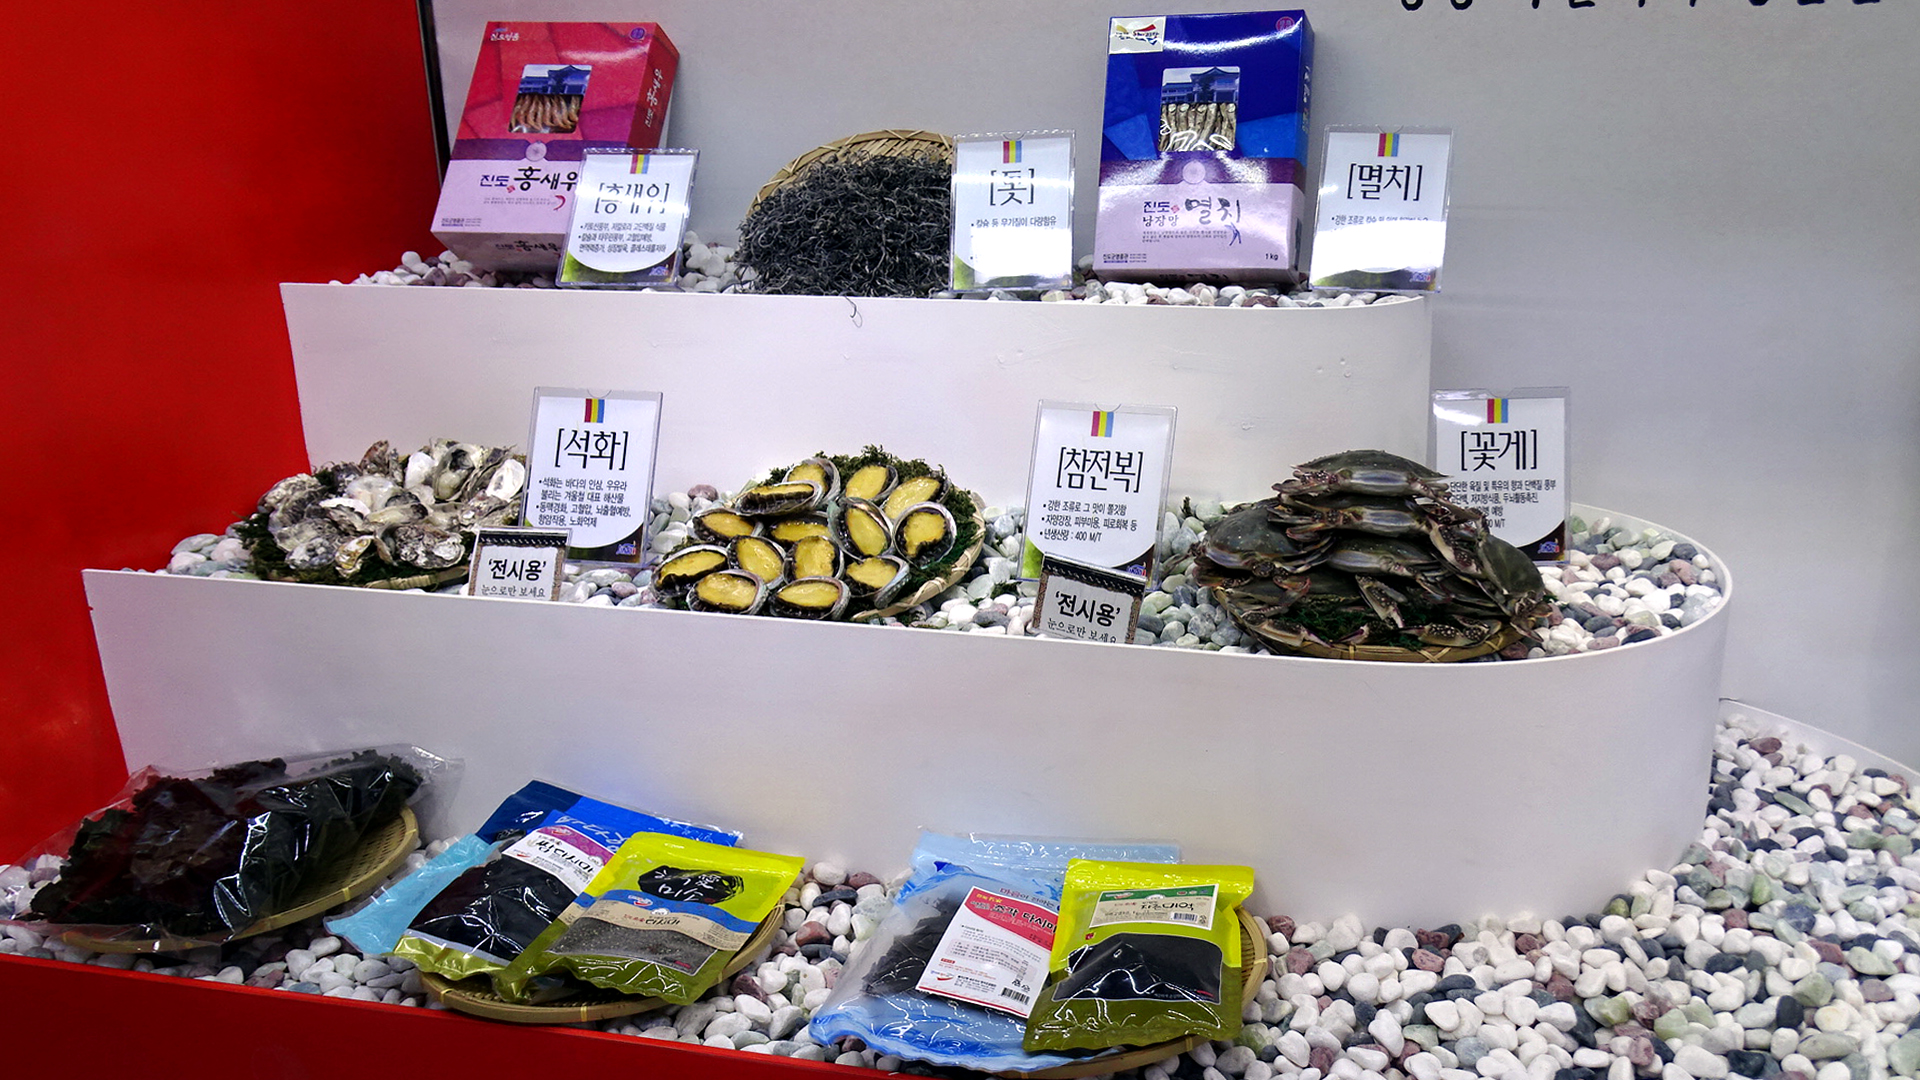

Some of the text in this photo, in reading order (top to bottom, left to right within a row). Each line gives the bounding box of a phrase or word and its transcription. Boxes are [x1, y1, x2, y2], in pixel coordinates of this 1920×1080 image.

[480, 166, 578, 191] 진도 홍새우
[1347, 163, 1423, 201] [멸치]
[1143, 196, 1240, 225] 진도 멸치
[554, 428, 629, 471] [석화]
[1461, 429, 1537, 471] [꽃게]
[1056, 446, 1143, 493] [참전복]
[542, 477, 563, 489] 석화는
[565, 478, 587, 490] 바다의
[606, 479, 627, 491] 우유라
[587, 492, 601, 502] 대표
[603, 492, 625, 504] 해산물
[1048, 500, 1061, 512] 강한
[1083, 503, 1091, 513] 그
[1092, 503, 1106, 514] 맛이
[1074, 531, 1088, 541] 400
[1089, 532, 1102, 542] M/T
[1130, 519, 1138, 532] 등
[481, 584, 546, 598] 눈으로만 보세요
[1047, 617, 1117, 643] 눈으로만 보세요
